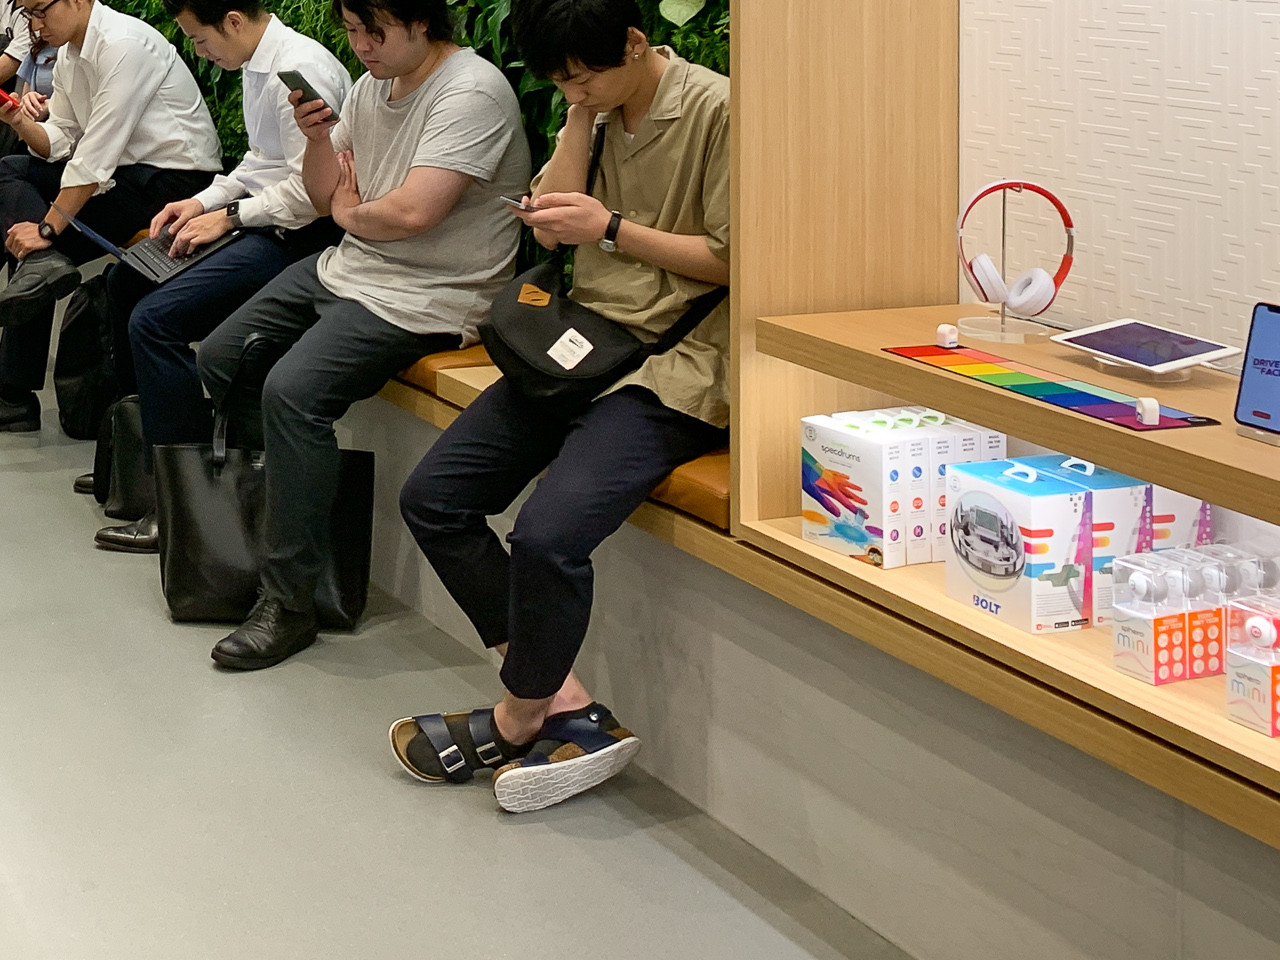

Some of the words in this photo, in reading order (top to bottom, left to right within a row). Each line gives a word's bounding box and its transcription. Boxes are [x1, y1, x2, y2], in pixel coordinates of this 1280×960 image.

[1261, 367, 1280, 377] FAC
[821, 444, 861, 463] specdrums
[972, 594, 1002, 615] BOLT
[1121, 625, 1145, 638] sphero
[1117, 632, 1149, 656] mini
[1235, 671, 1262, 685] sphero
[1231, 679, 1266, 705] mini
